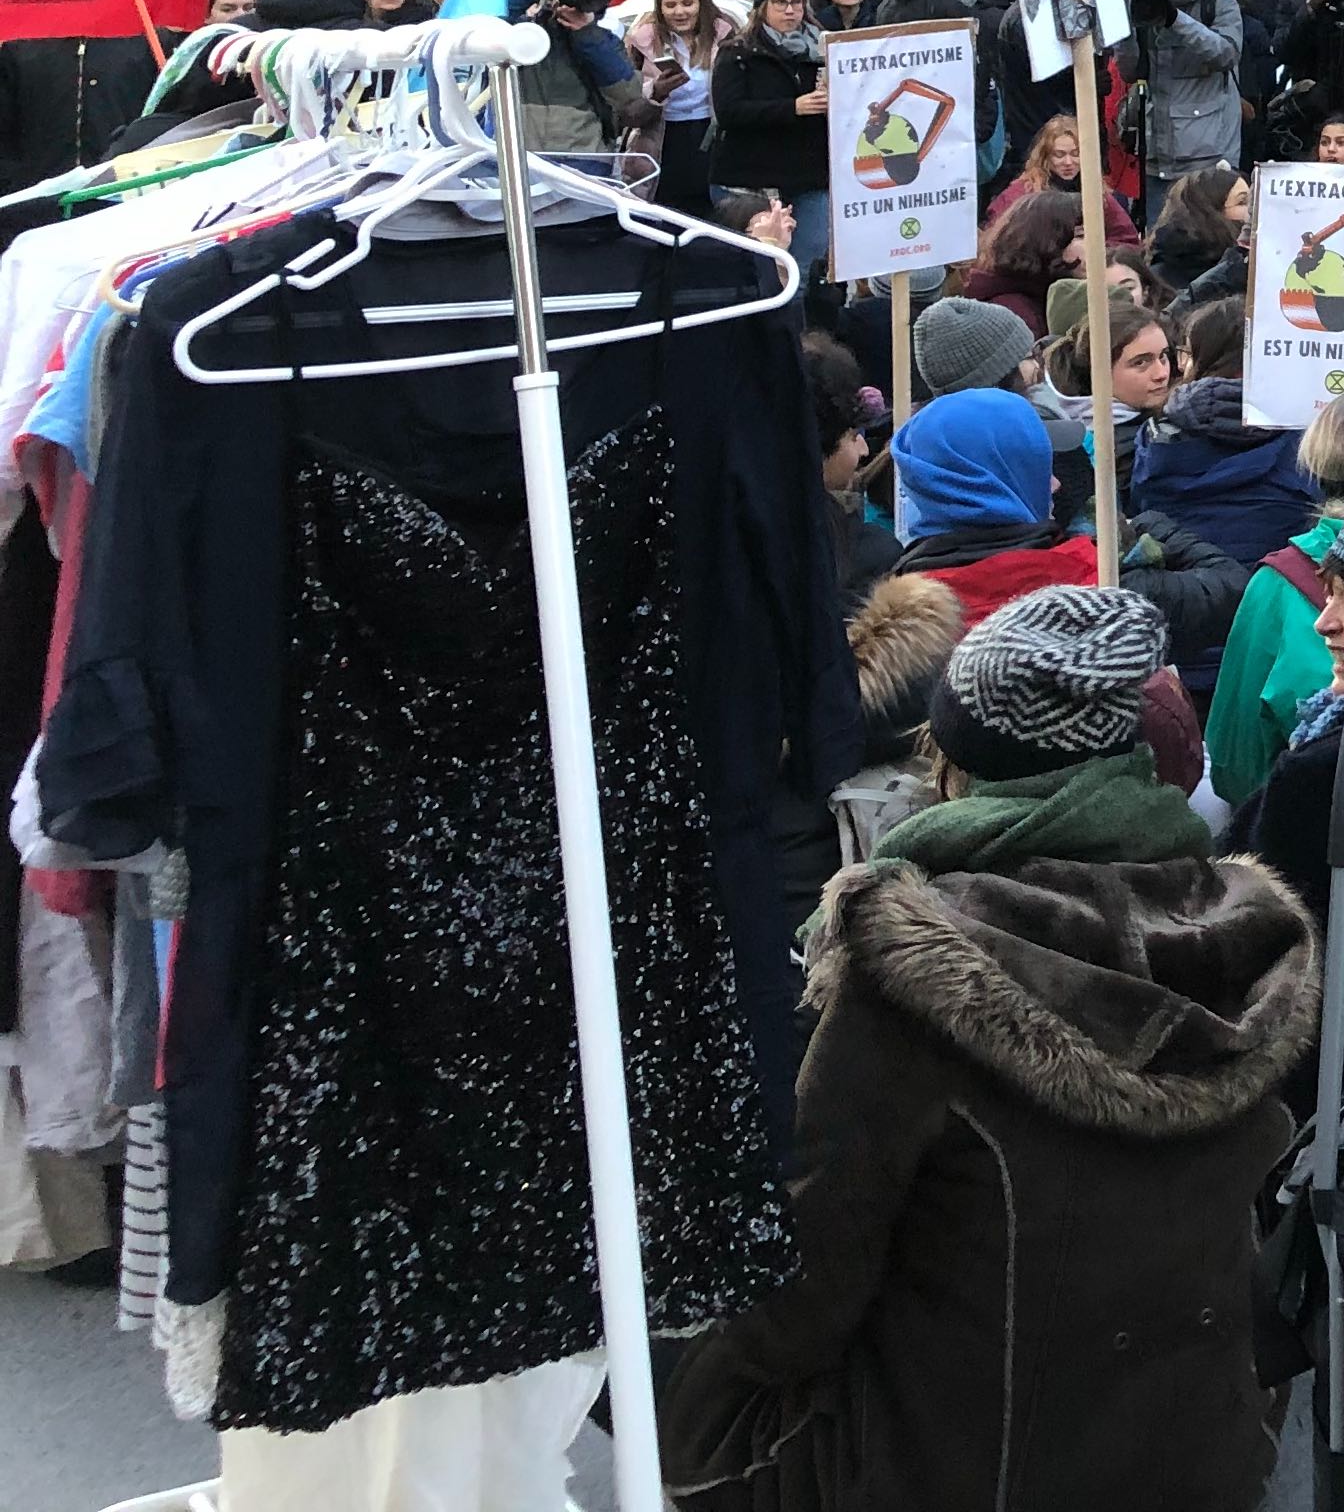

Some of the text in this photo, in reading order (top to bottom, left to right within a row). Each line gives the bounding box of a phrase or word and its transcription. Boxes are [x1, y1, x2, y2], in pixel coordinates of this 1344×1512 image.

[837, 45, 963, 75] L'EXTRACTIVISME
[844, 187, 967, 219] EST UN NIHILISME
[1263, 339, 1293, 357] EST
[1299, 342, 1321, 359] UN
